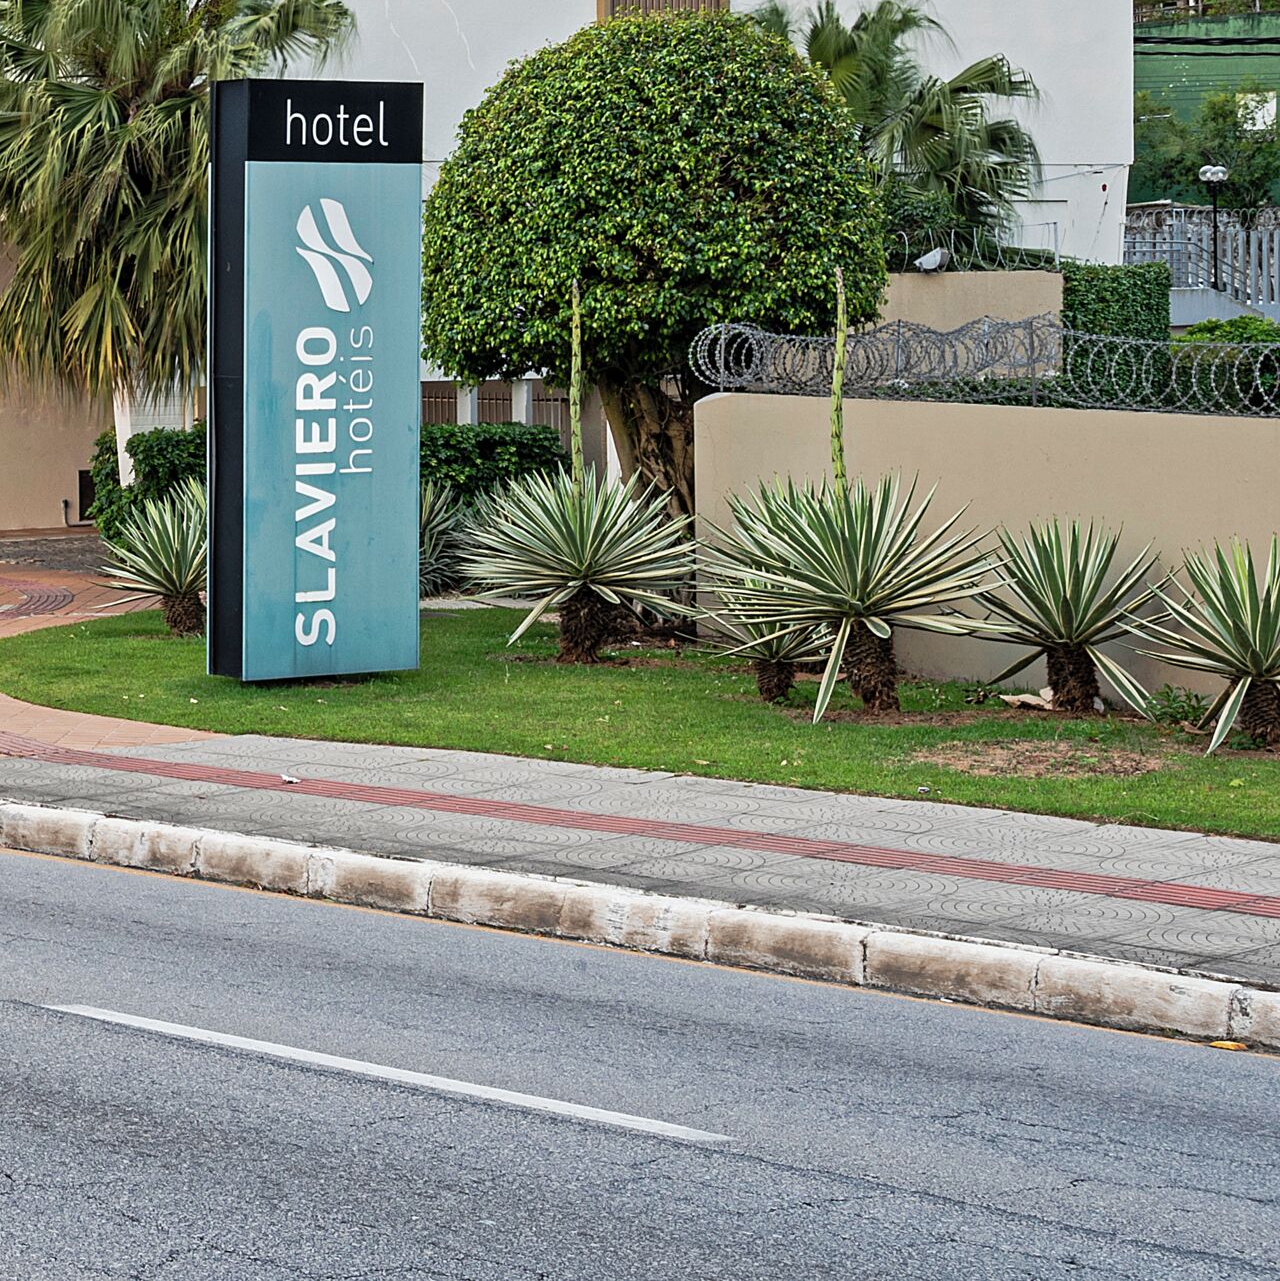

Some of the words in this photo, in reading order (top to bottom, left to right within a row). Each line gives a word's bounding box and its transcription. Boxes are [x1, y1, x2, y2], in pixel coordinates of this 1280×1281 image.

[285, 99, 389, 146] hotel
[340, 324, 374, 474] hotéis
[295, 326, 338, 648] SLAVIERO
